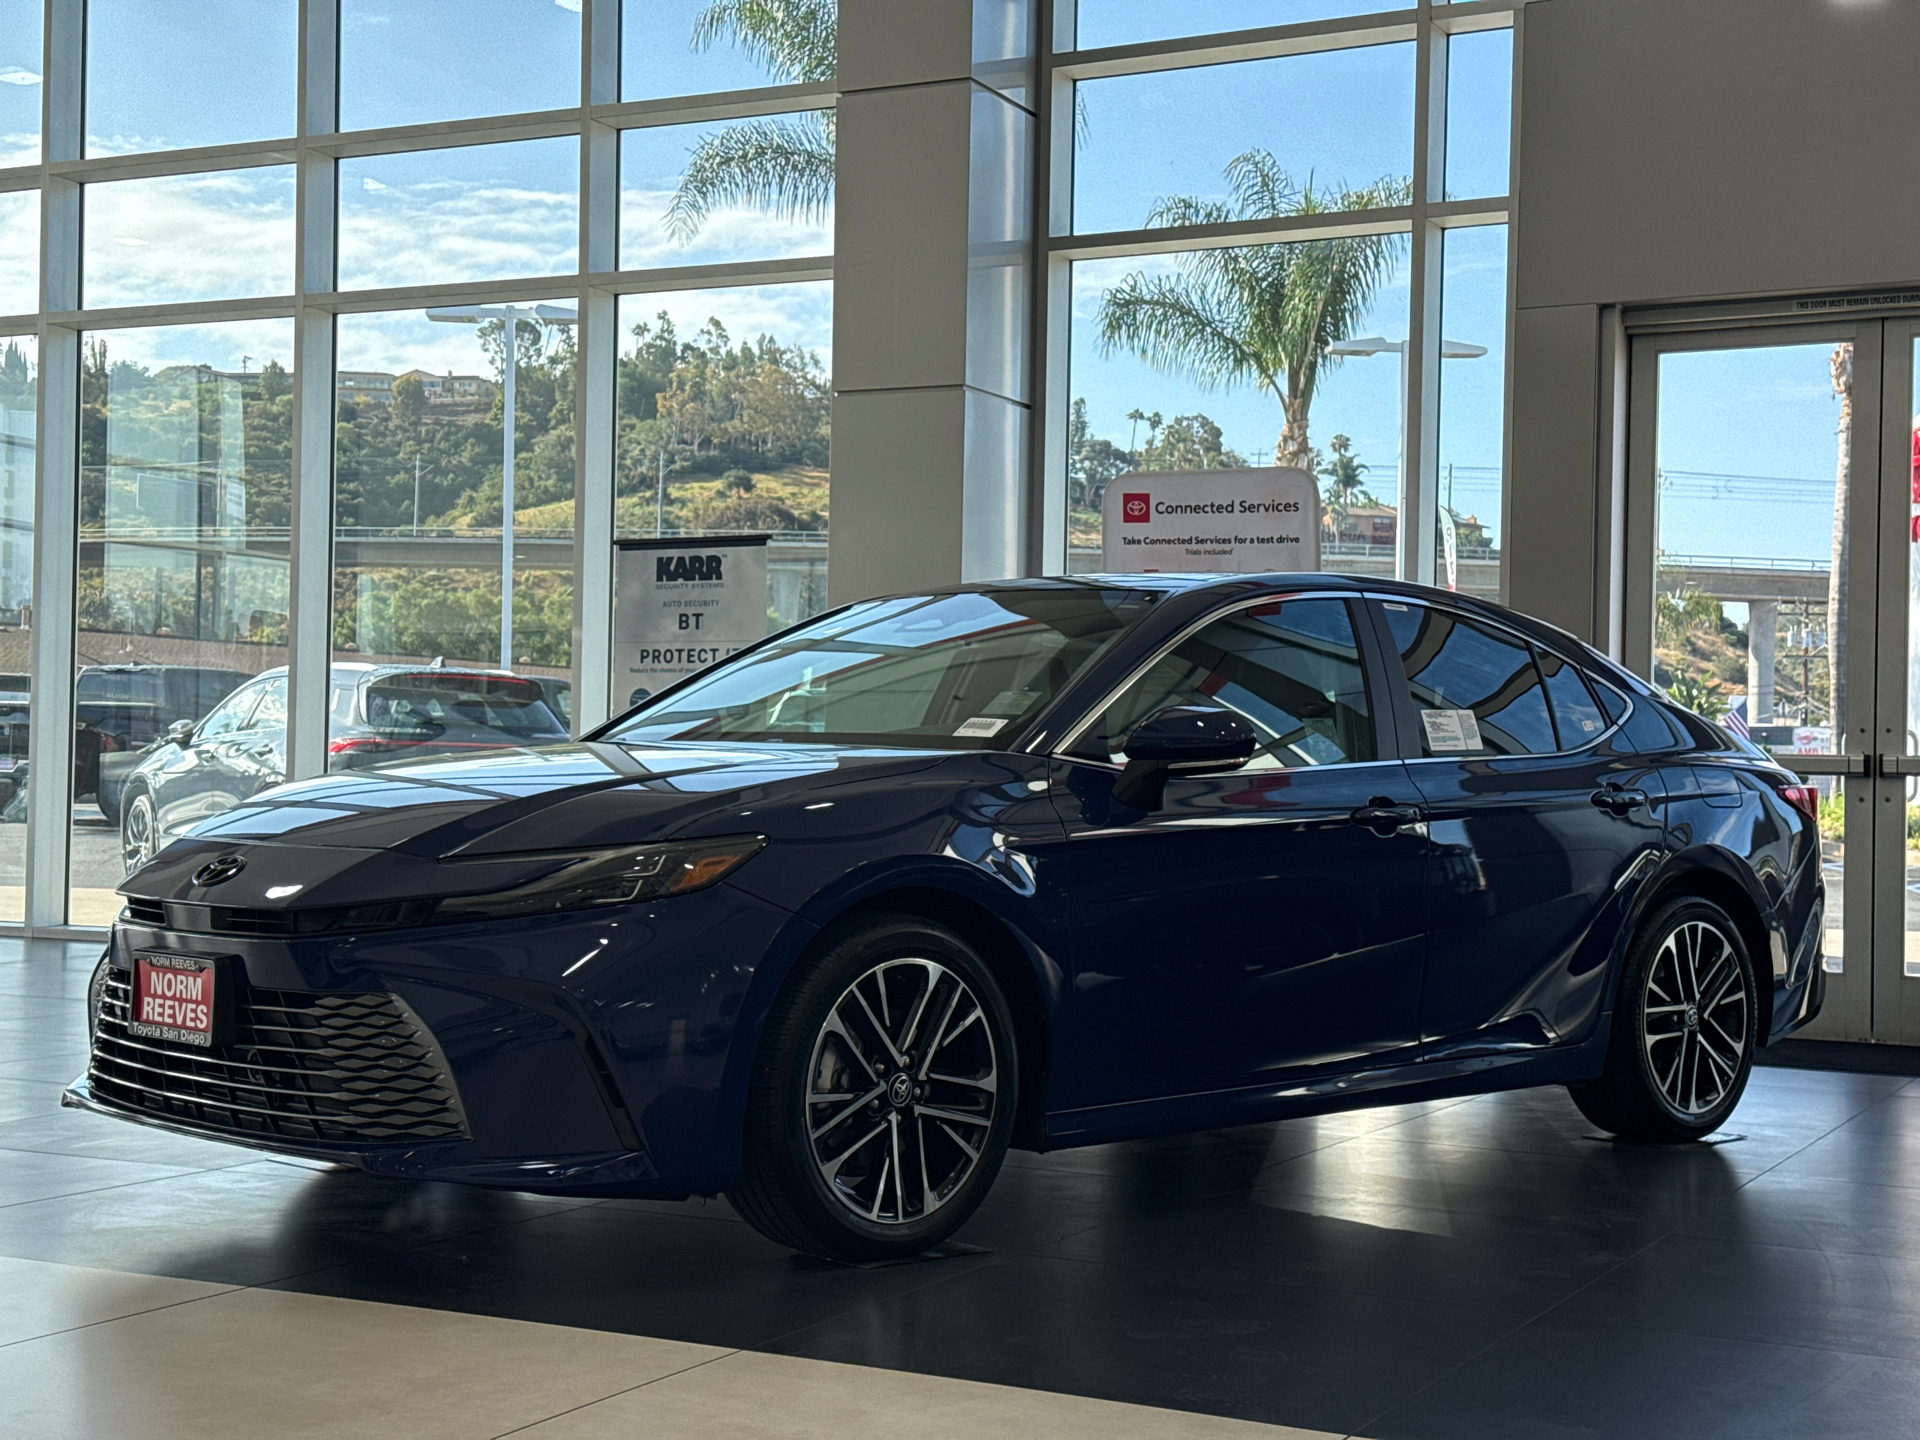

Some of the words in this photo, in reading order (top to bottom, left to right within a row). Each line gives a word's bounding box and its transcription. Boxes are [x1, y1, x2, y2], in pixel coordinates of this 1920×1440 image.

[1796, 301, 1809, 309] THIS
[1810, 300, 1827, 308] DOOR
[1828, 299, 1845, 308] MUST
[1846, 297, 1869, 307] REMAIN
[1870, 295, 1901, 306] UNLOCKED
[1155, 500, 1234, 515] Connected
[1239, 499, 1299, 514] Services
[1122, 536, 1142, 545] Take
[1144, 535, 1193, 545] Connected
[1194, 535, 1232, 545] Services
[1234, 534, 1248, 544] for
[1256, 535, 1275, 544] test
[1276, 534, 1300, 544] drive
[1203, 548, 1234, 556] included
[656, 554, 723, 582] KARR
[662, 600, 682, 608] AUTO
[683, 600, 720, 608] SECURITY
[678, 613, 704, 630] BT
[640, 648, 720, 664] PROTECT
[151, 956, 170, 967] NORM
[171, 958, 196, 970] REEVES
[150, 971, 202, 1001] NORM
[142, 996, 208, 1029] REEVES
[132, 1021, 160, 1037] Toyota
[162, 1027, 178, 1040] San
[180, 1030, 205, 1046] Diego
